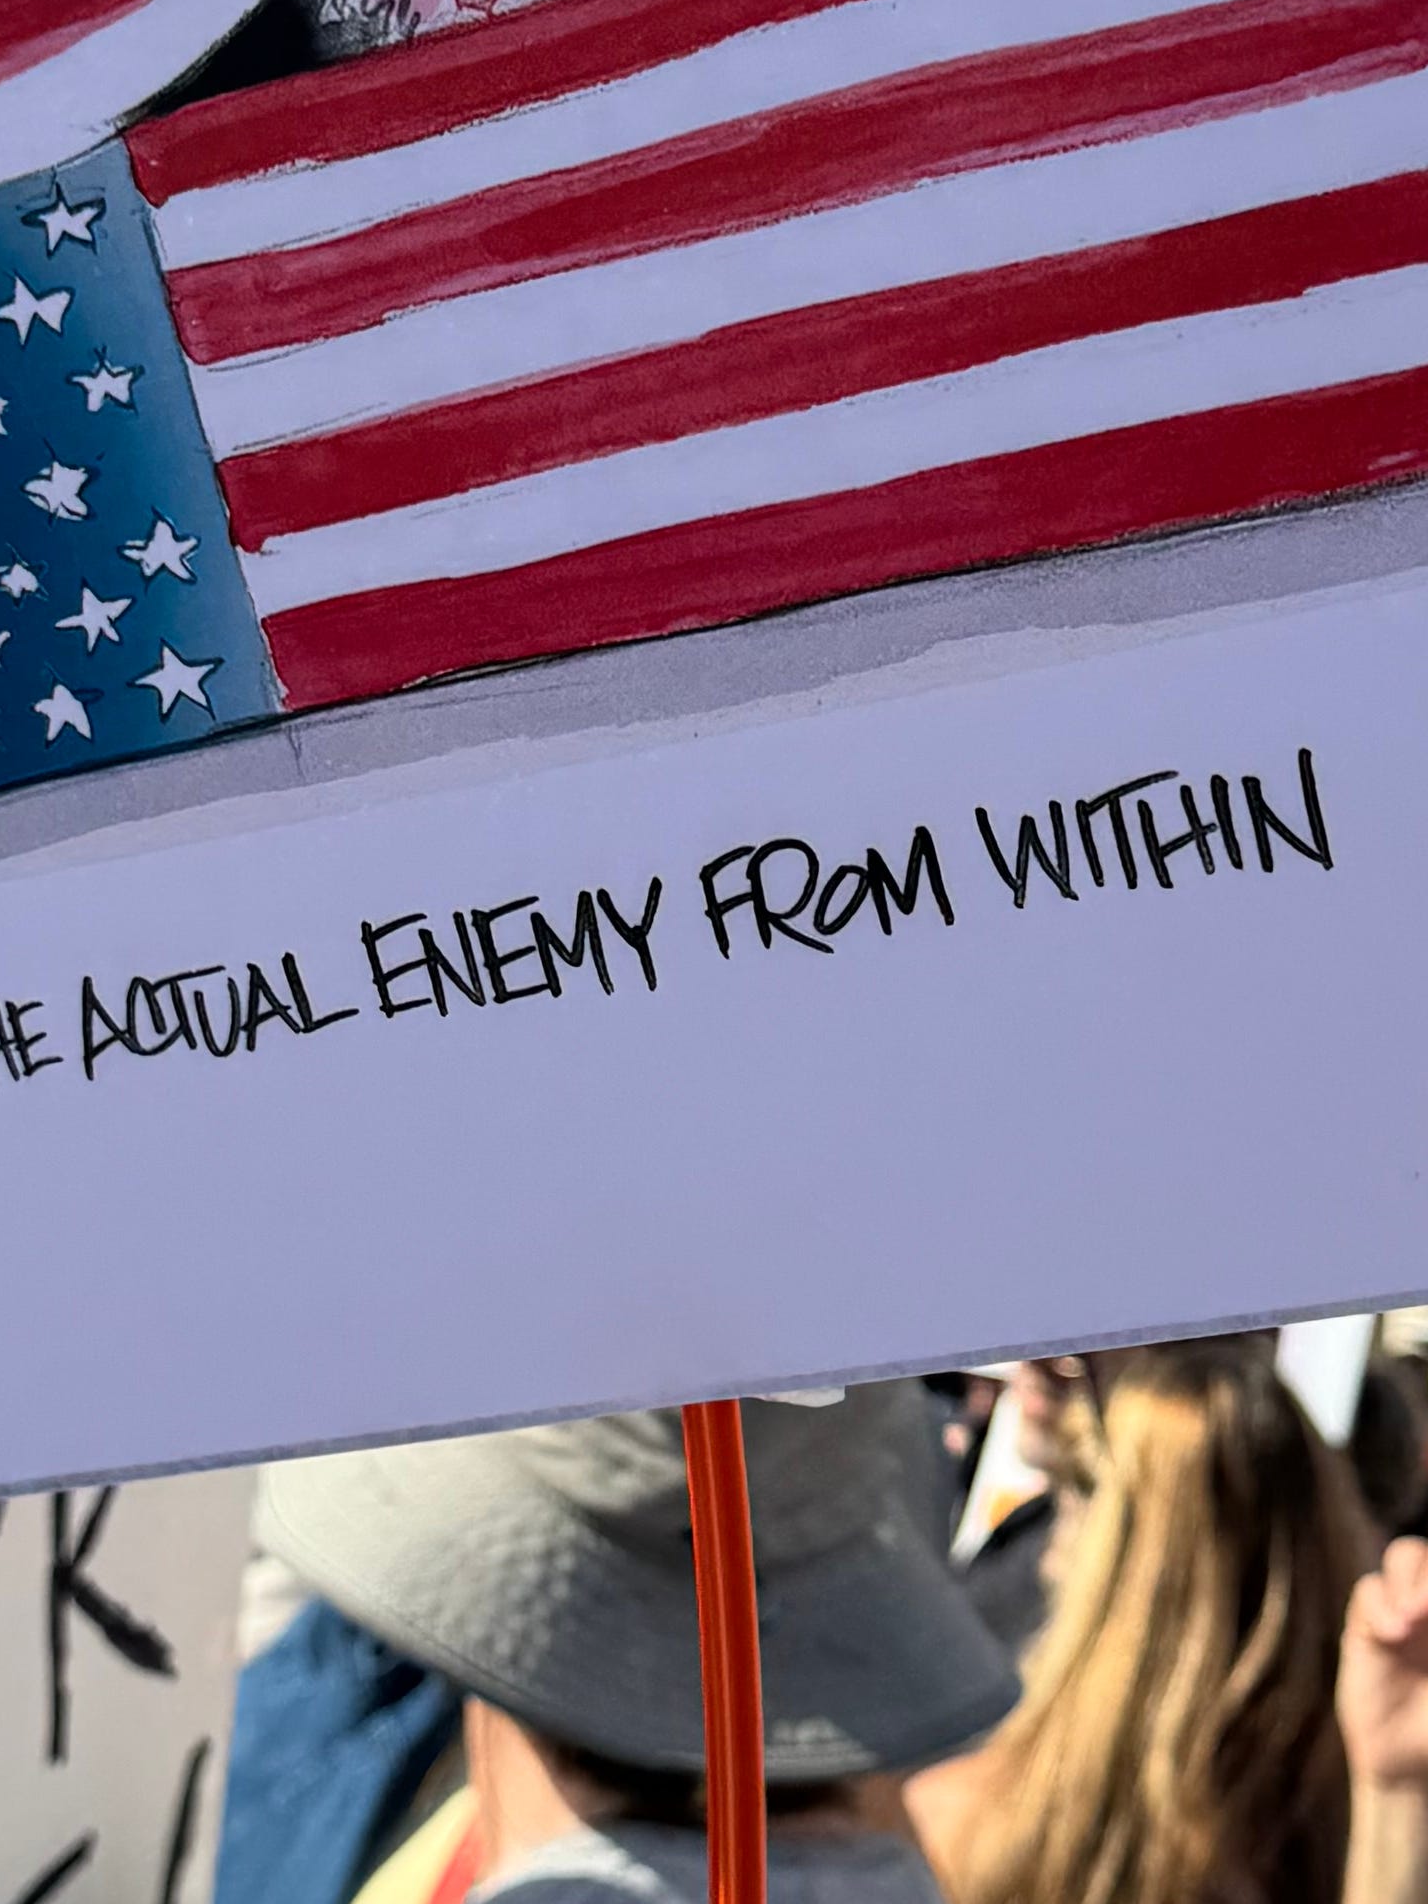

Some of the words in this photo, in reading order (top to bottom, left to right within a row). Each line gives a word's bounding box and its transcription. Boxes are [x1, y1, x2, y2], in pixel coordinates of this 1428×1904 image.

[80, 950, 361, 1083] ACTUAL
[360, 875, 664, 1021] ENEMY
[698, 825, 956, 961] FROM
[974, 746, 1335, 911] WITHIN
